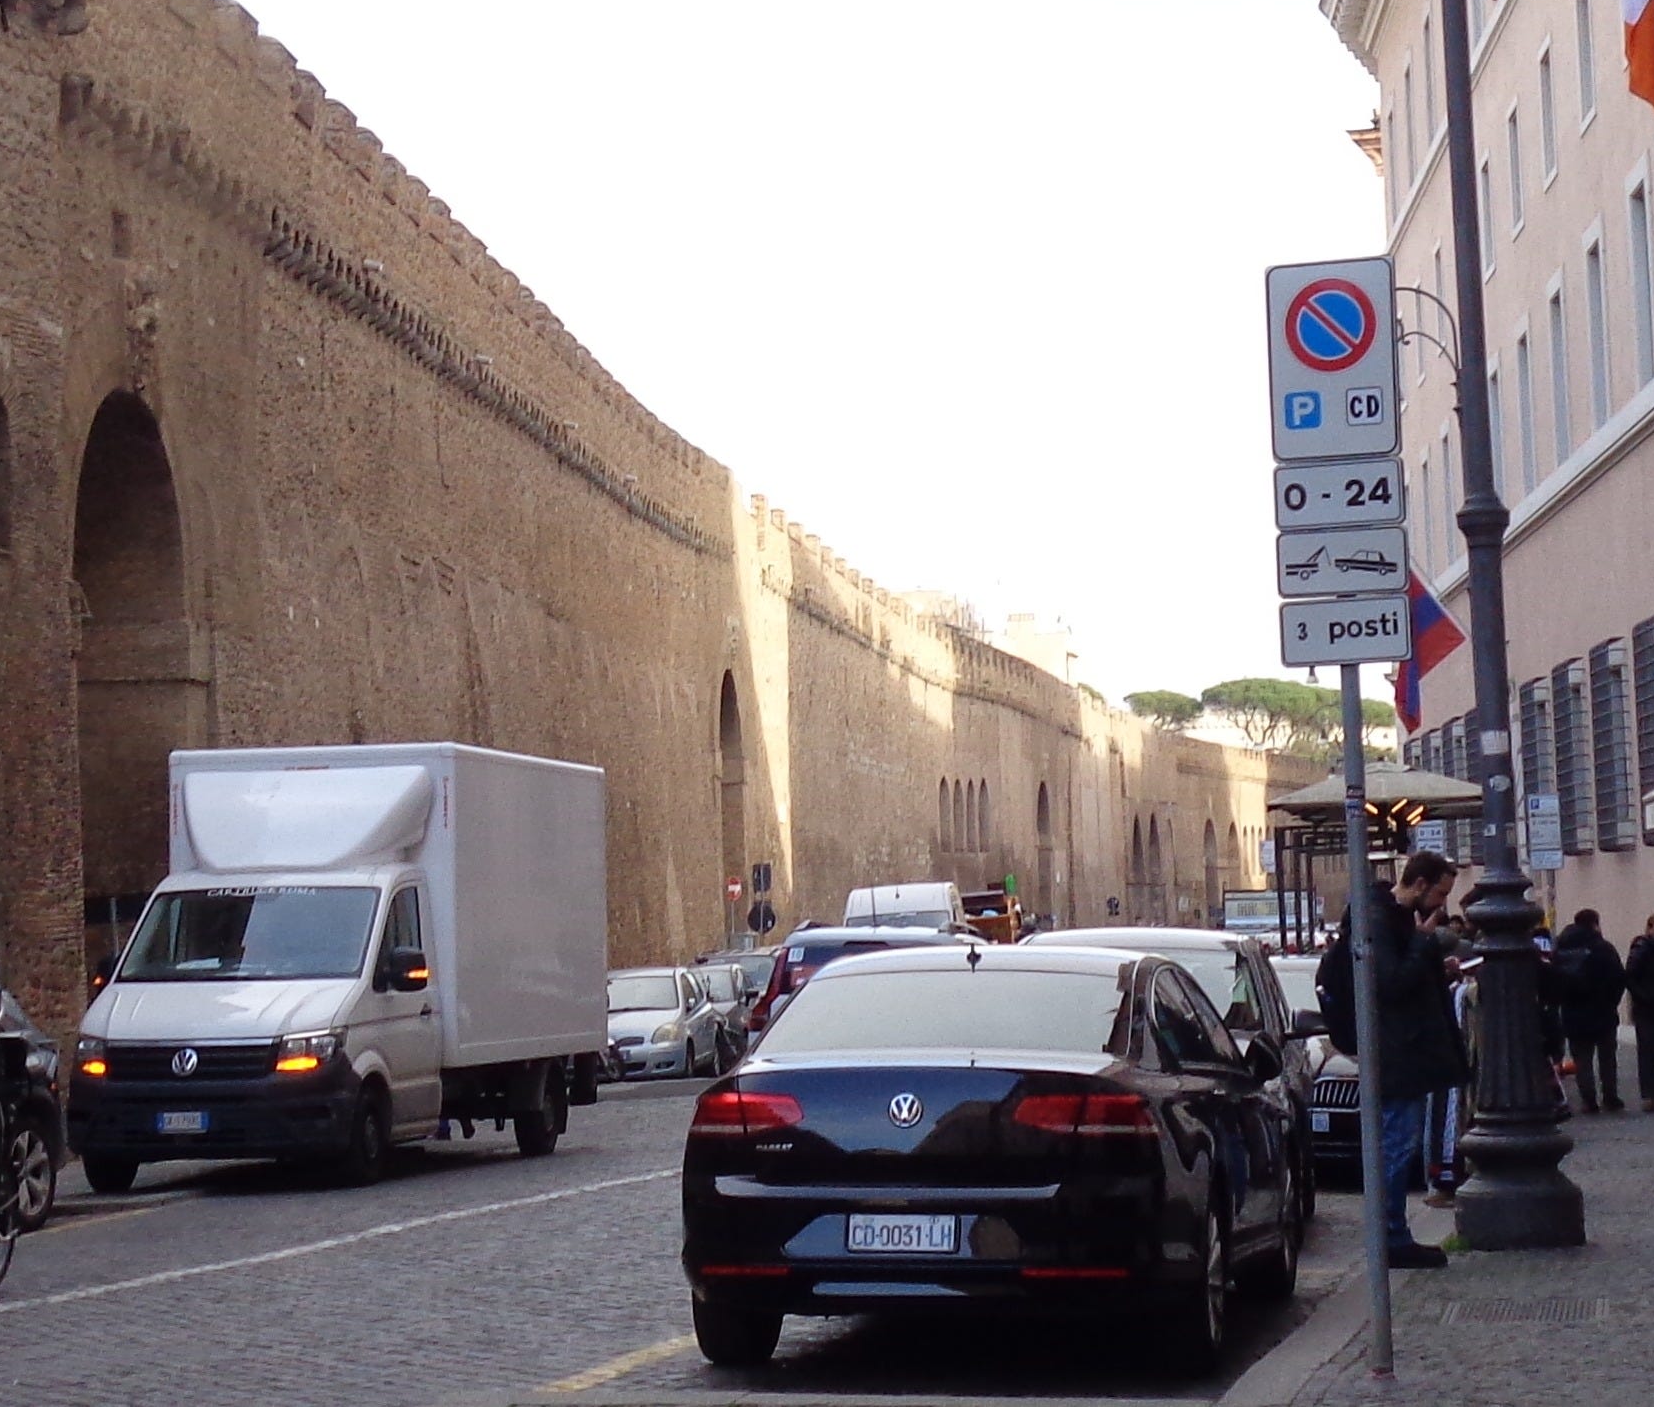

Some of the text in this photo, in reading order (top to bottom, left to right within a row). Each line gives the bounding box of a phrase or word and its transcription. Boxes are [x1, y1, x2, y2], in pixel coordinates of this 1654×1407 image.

[1292, 396, 1315, 426] P
[1349, 395, 1380, 419] CD
[1284, 483, 1307, 511] 0
[1344, 476, 1393, 507] 24
[1297, 611, 1399, 645] 3 posti
